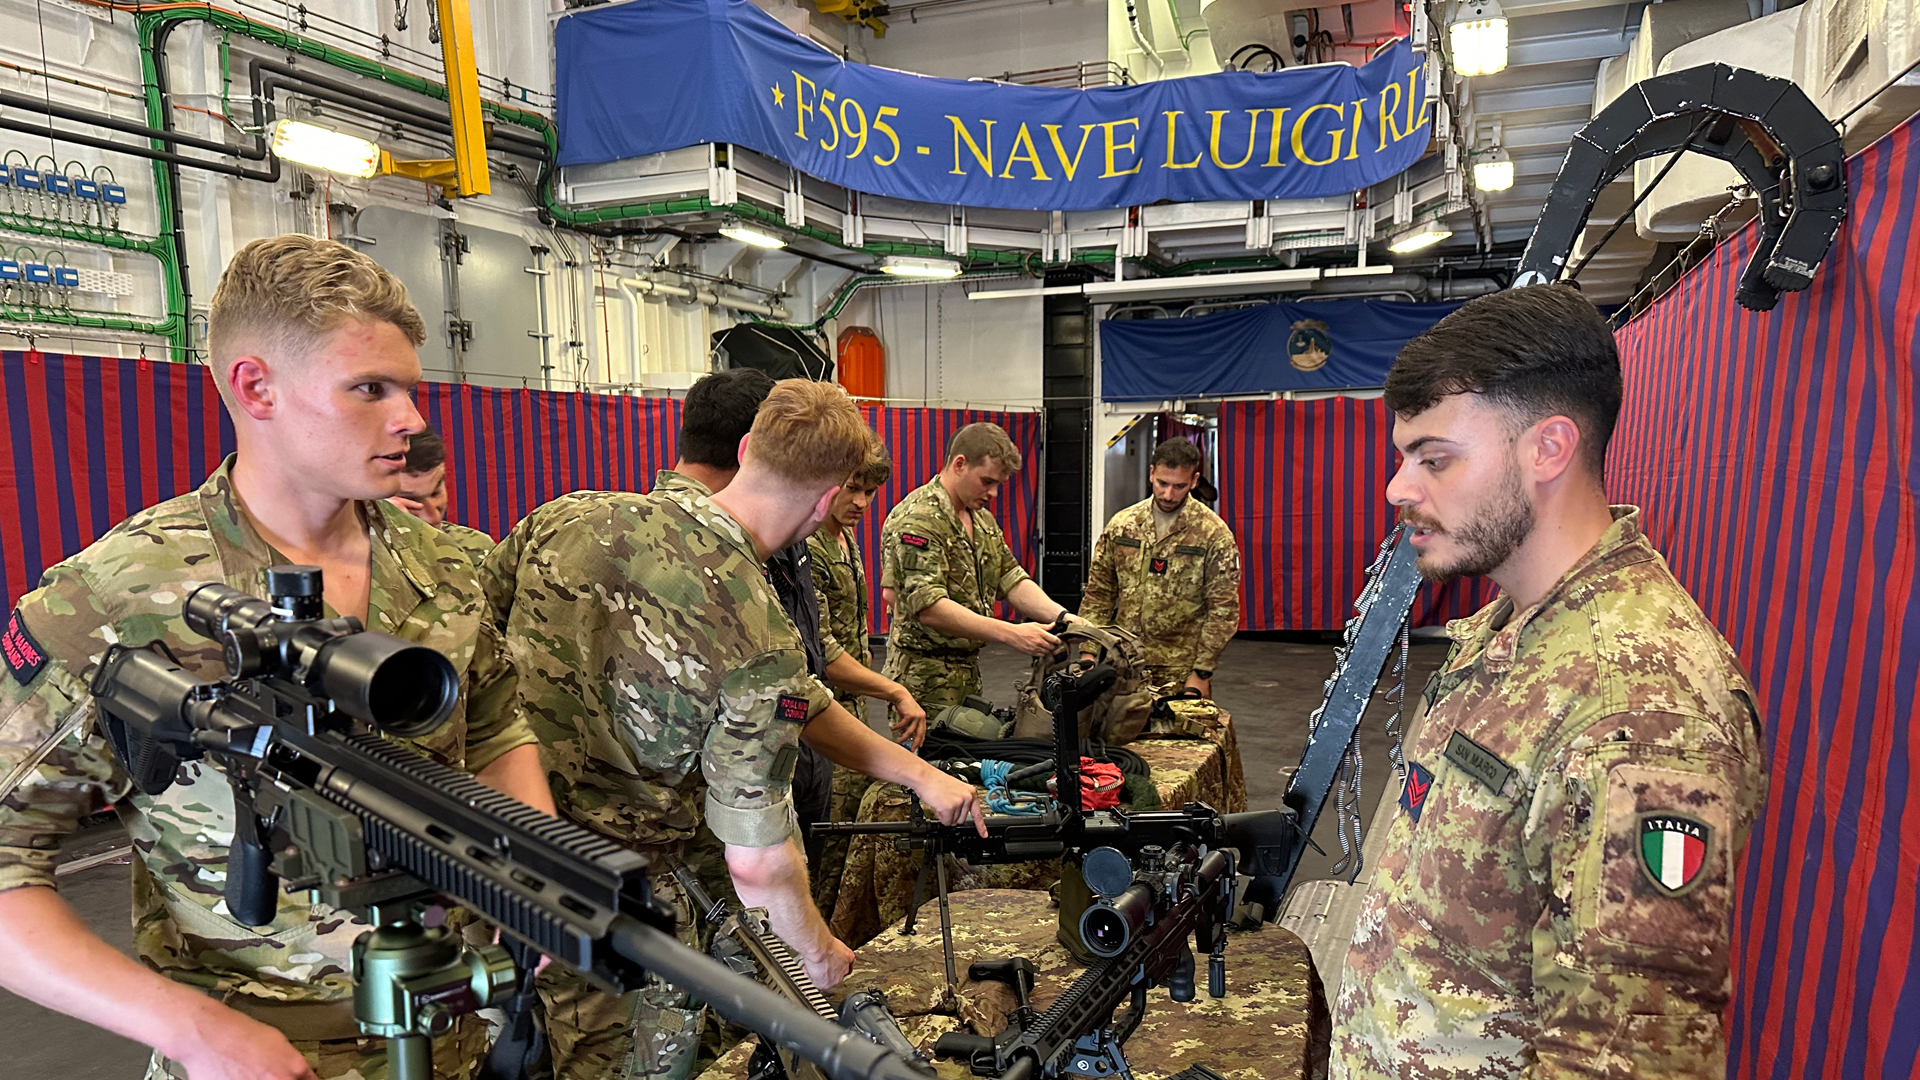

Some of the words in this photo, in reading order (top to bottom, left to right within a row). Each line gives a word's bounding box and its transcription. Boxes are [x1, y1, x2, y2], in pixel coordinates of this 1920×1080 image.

[791, 69, 900, 167] F595
[944, 115, 1143, 182] NAVE
[1160, 98, 1368, 170] LUIGI
[1455, 743, 1471, 761] SAN
[1470, 753, 1498, 780] MARCO
[1647, 819, 1700, 837] ITALIA
